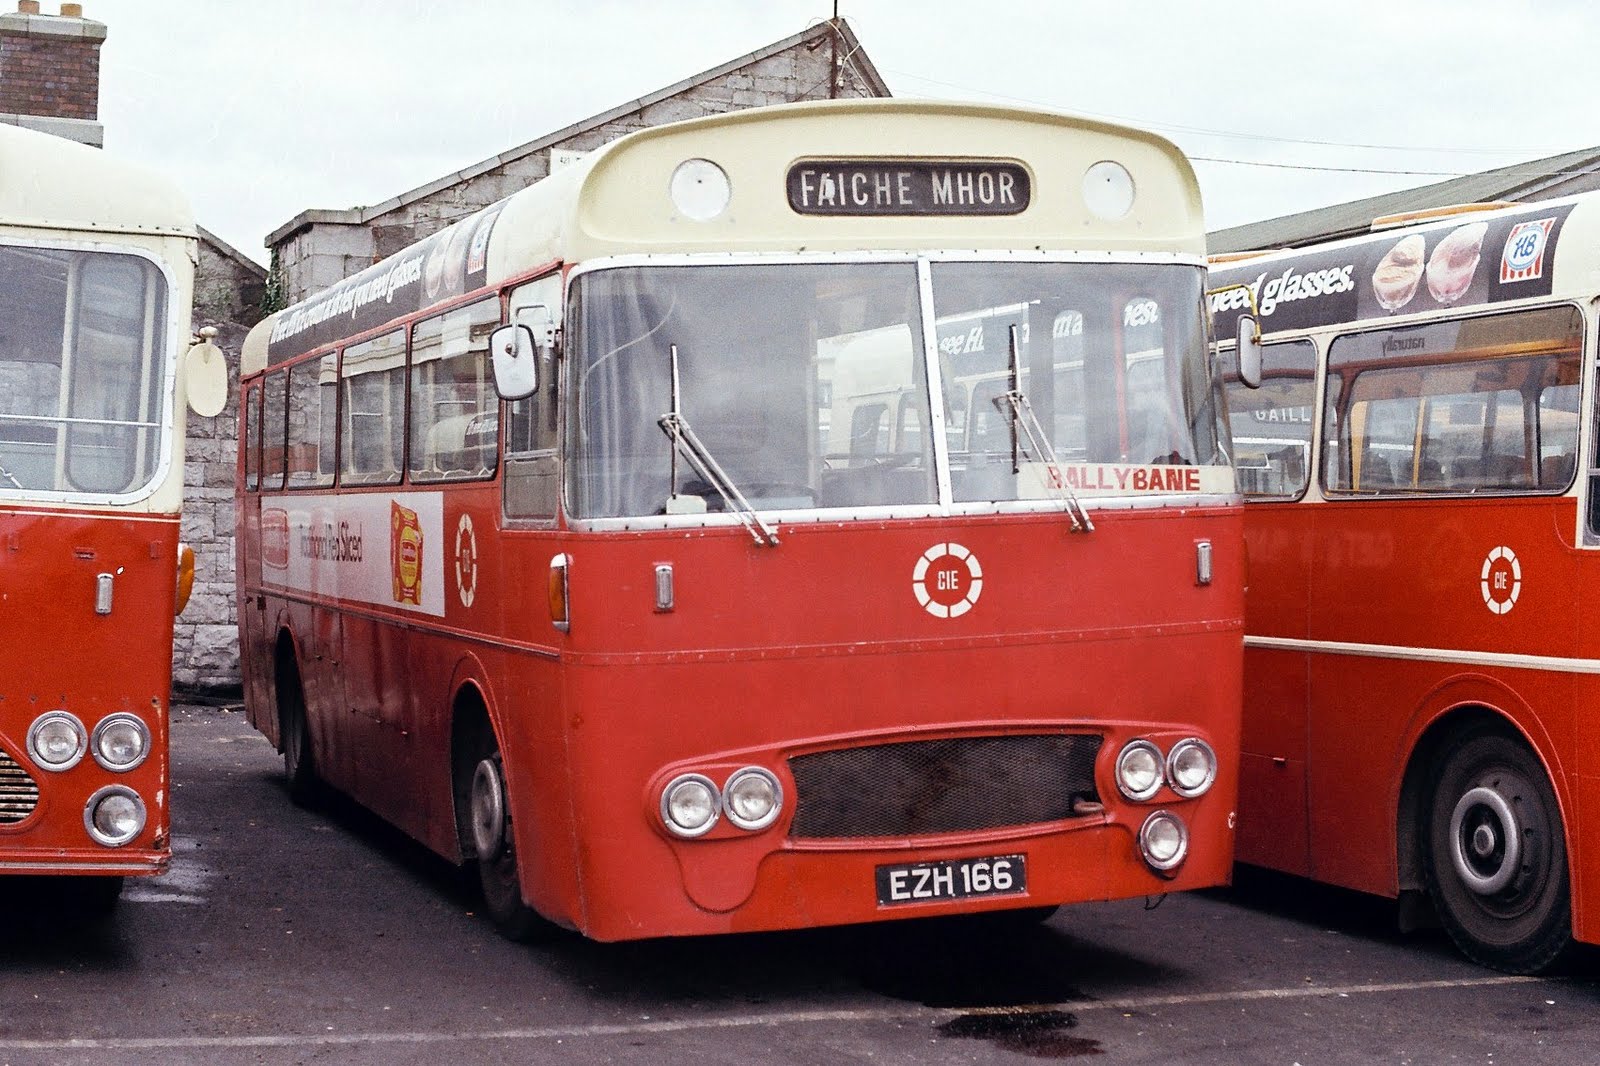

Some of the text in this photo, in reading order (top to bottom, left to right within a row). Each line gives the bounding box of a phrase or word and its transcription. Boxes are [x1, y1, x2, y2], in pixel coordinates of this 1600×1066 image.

[801, 170, 1016, 206] FAICHE MHOR
[1513, 233, 1537, 259] HB
[1259, 264, 1355, 317] glasses.
[1047, 466, 1200, 492] BALLYBANE
[937, 570, 959, 590] CIE
[1494, 571, 1508, 589] CIE
[890, 861, 1013, 900] EZH 166
